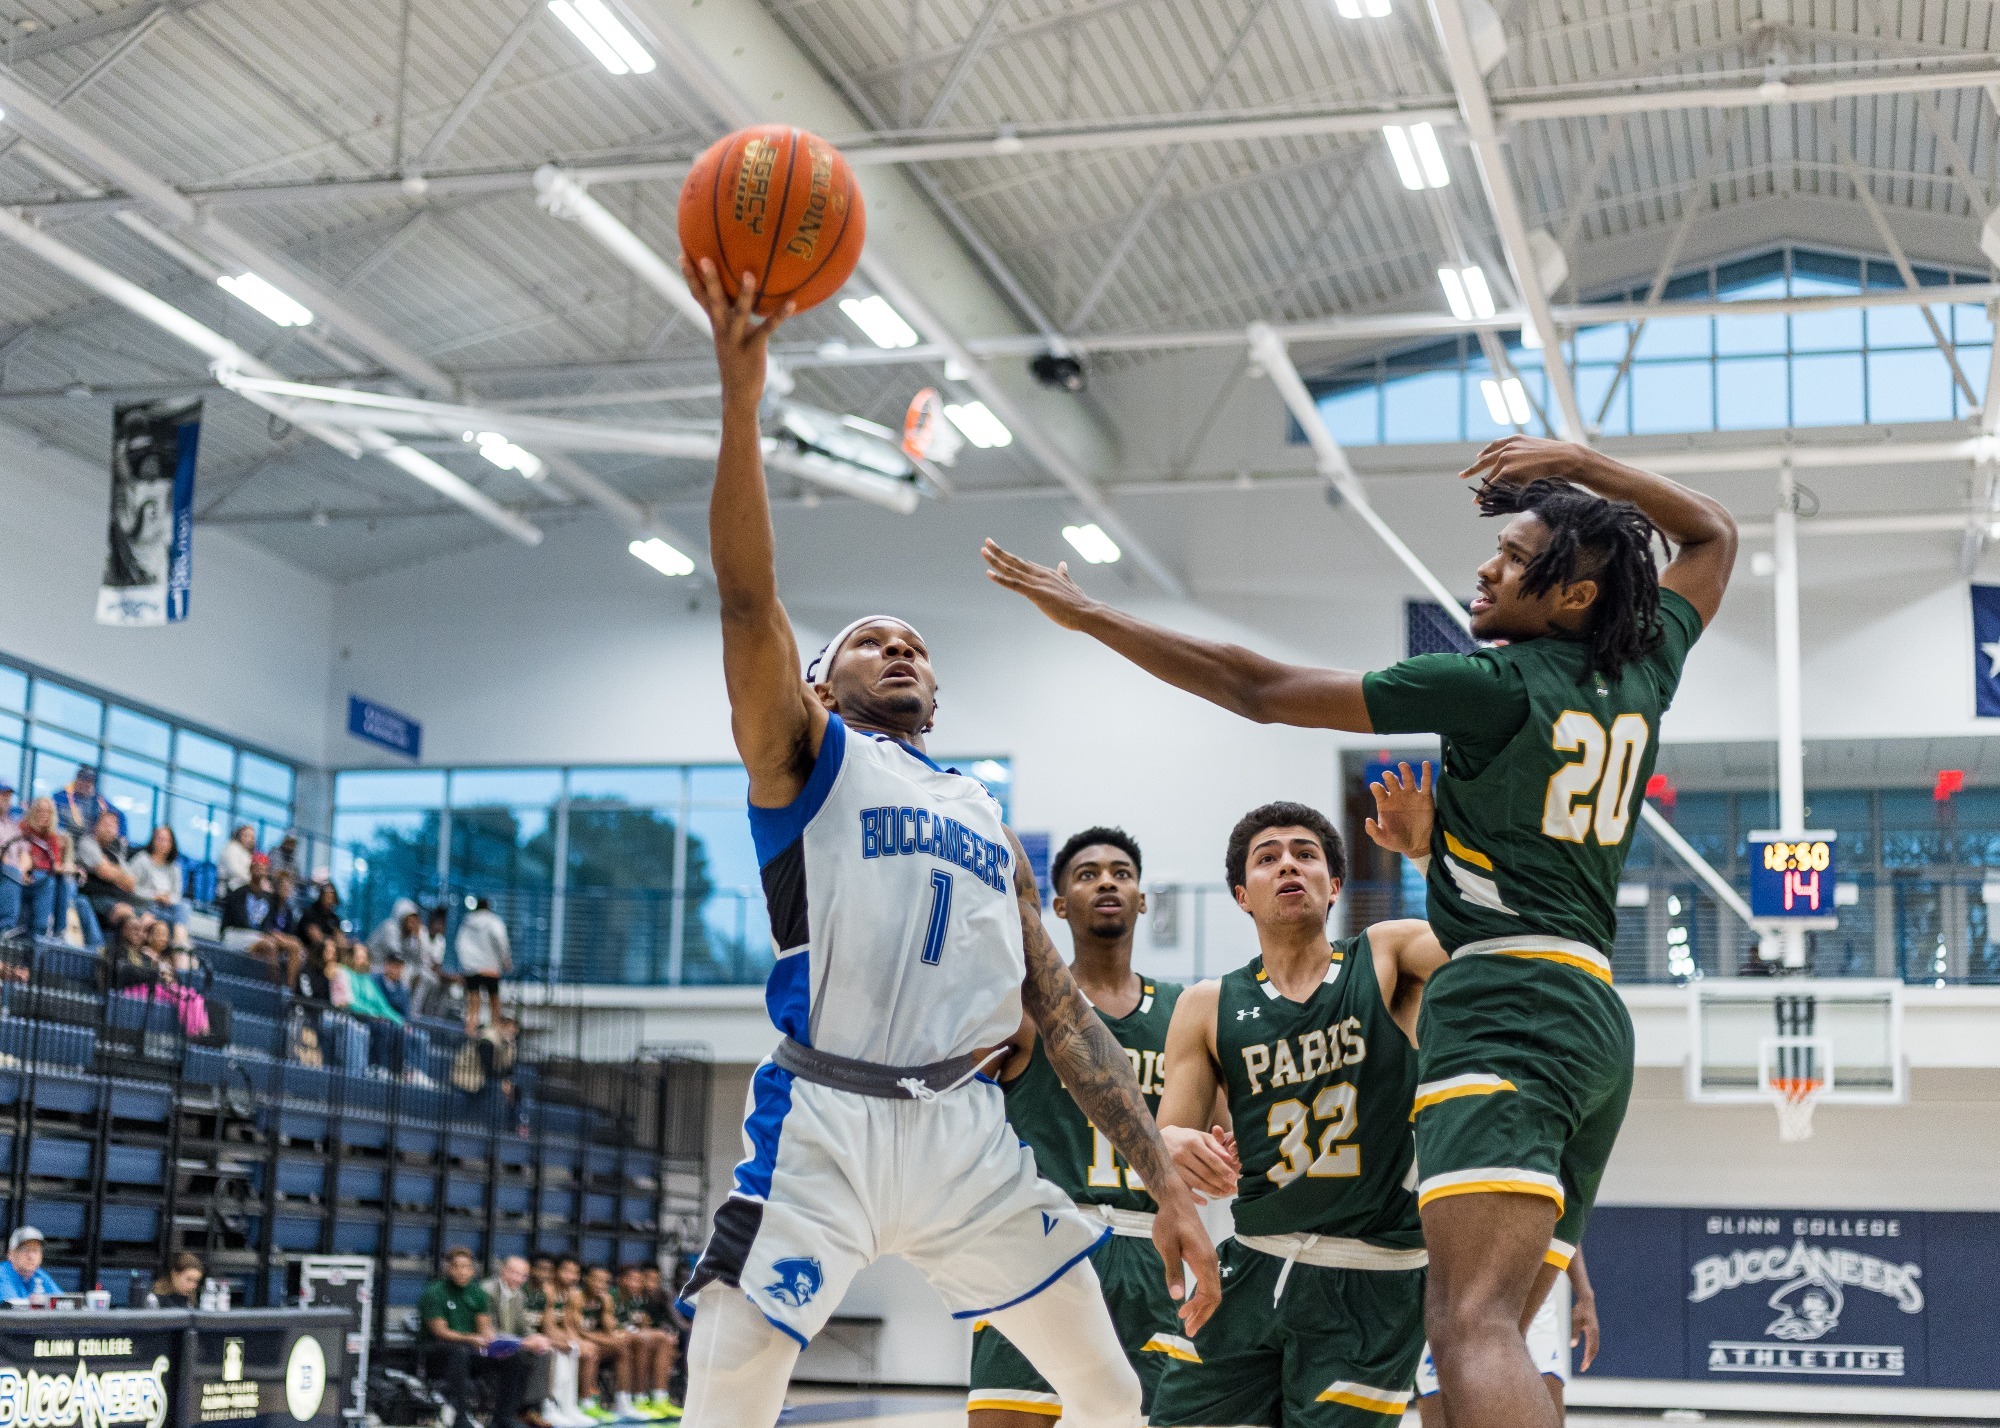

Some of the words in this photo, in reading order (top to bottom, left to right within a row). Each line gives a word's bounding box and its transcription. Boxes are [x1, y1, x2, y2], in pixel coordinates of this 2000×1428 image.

[1541, 709, 1649, 846] 20
[920, 868, 953, 966] 1
[1784, 870, 1820, 911] 14
[1241, 1015, 1367, 1096] PARIS
[1266, 1081, 1361, 1190] 32
[1706, 1216, 1780, 1235] BLINN
[1792, 1218, 1901, 1237] COLLEGE
[1708, 1349, 1905, 1370] ATHLETICS
